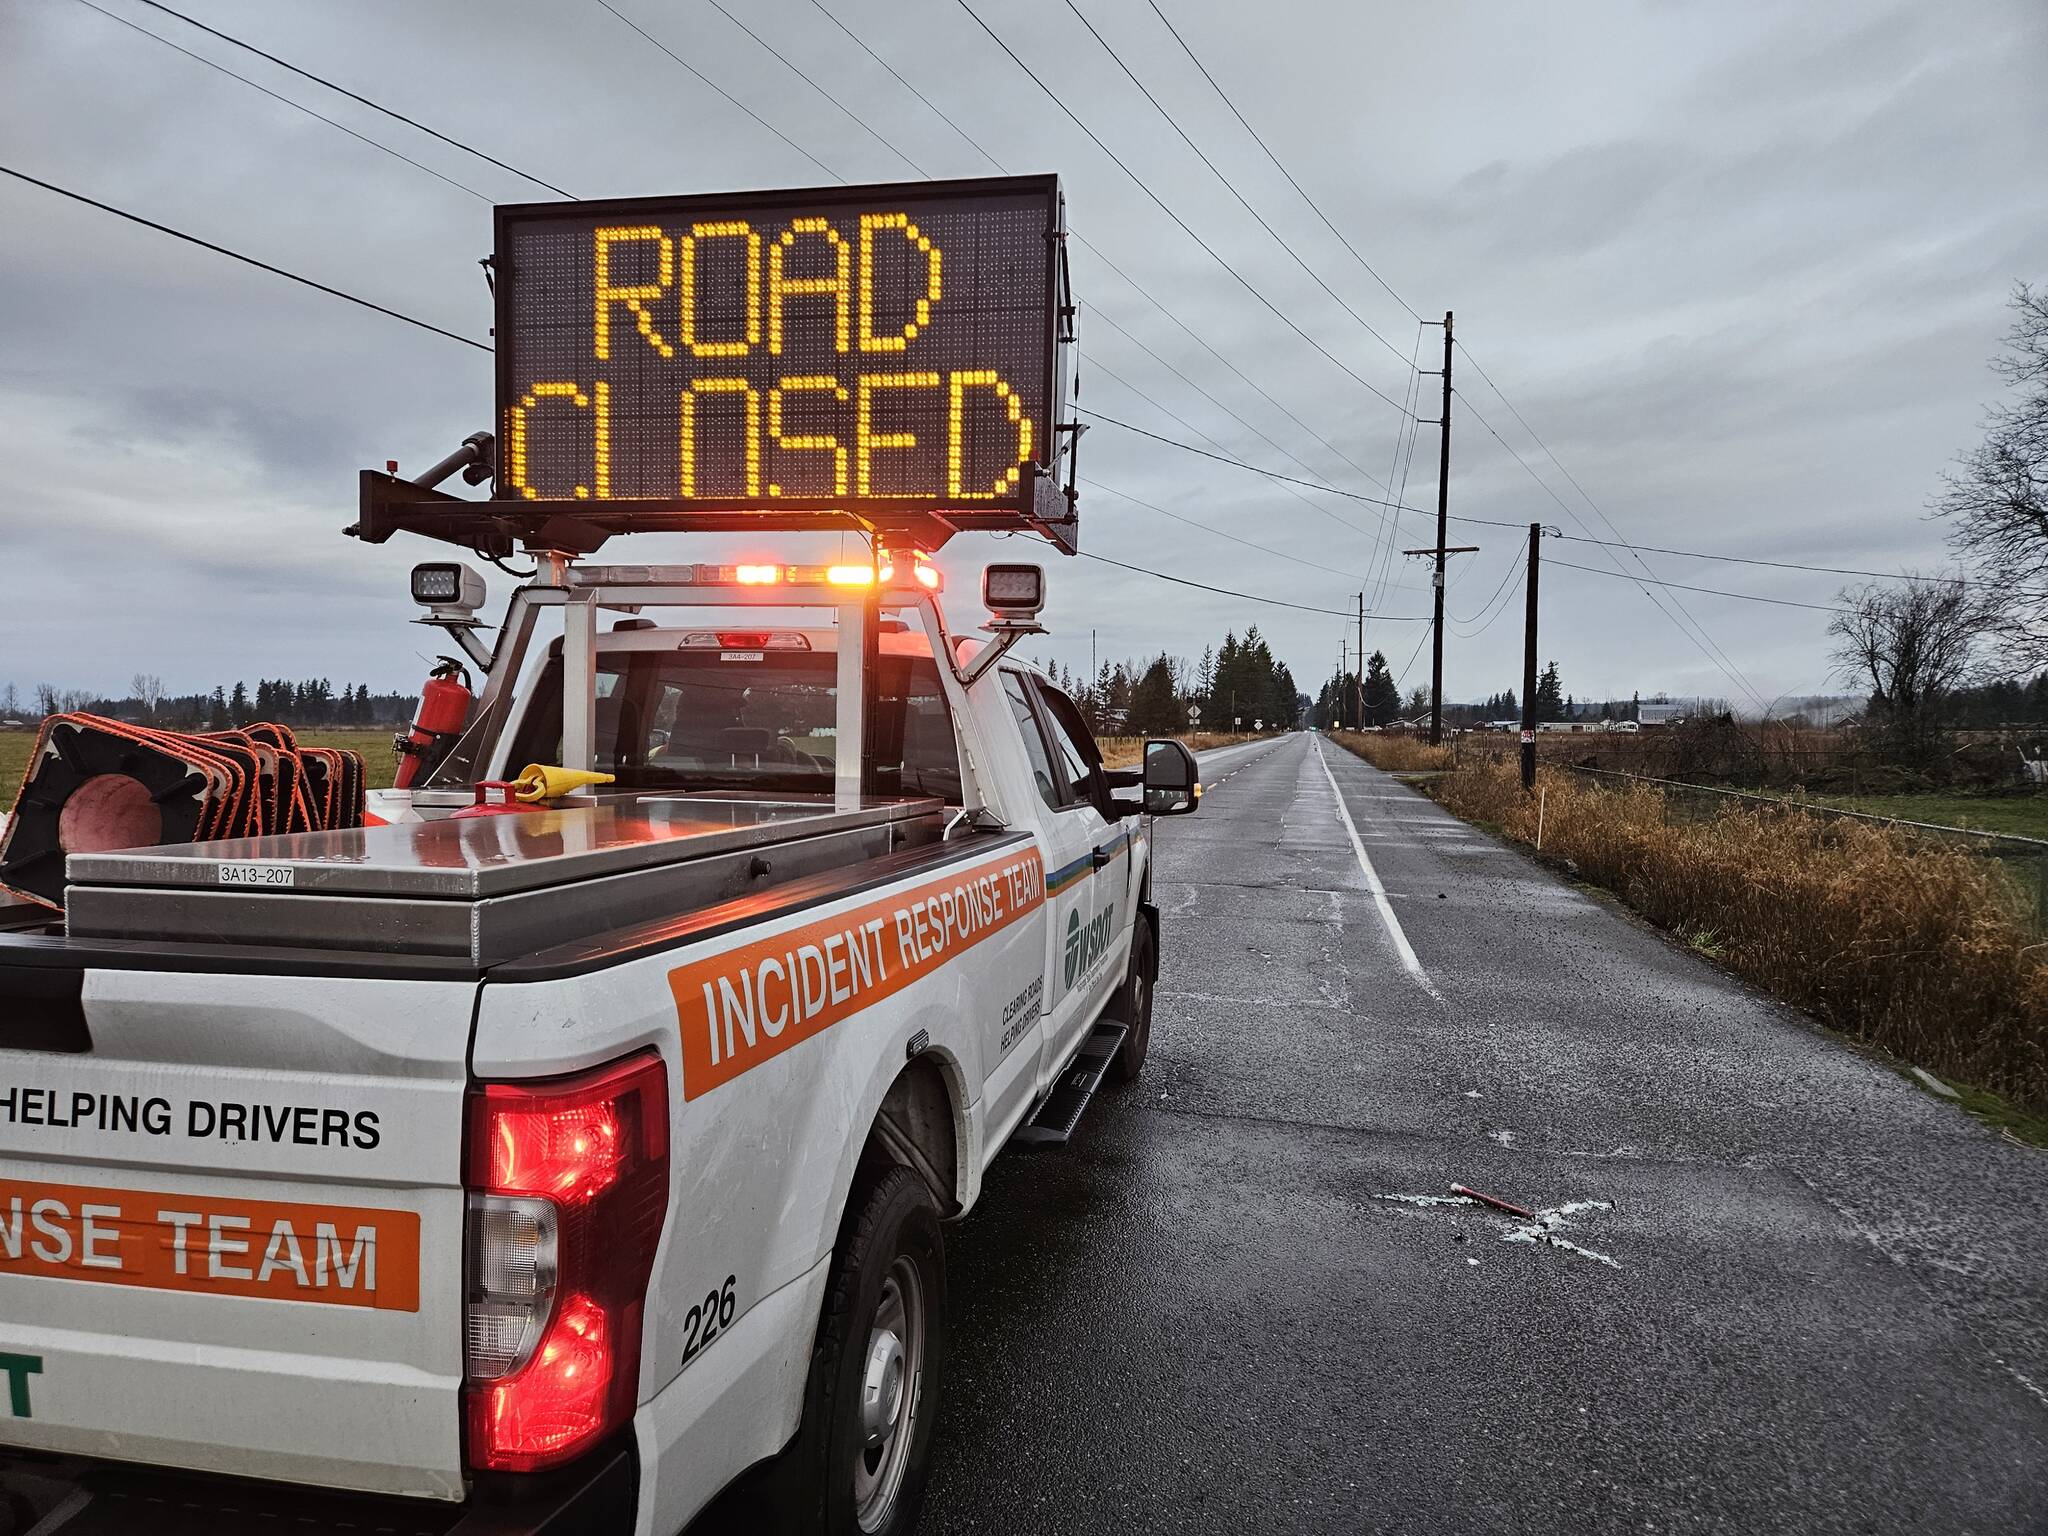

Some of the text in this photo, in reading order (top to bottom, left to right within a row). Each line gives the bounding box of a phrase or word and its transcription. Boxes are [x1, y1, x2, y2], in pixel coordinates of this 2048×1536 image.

[595, 212, 942, 359] ROAD
[221, 867, 292, 884] 3A13-207
[702, 857, 1041, 1067] INCIDENT RESPONSE TEAM
[1078, 902, 1114, 977] WSDOT
[187, 1100, 380, 1149] DRIVERS
[157, 1210, 376, 1290] TEAM
[681, 1274, 736, 1367] 226
